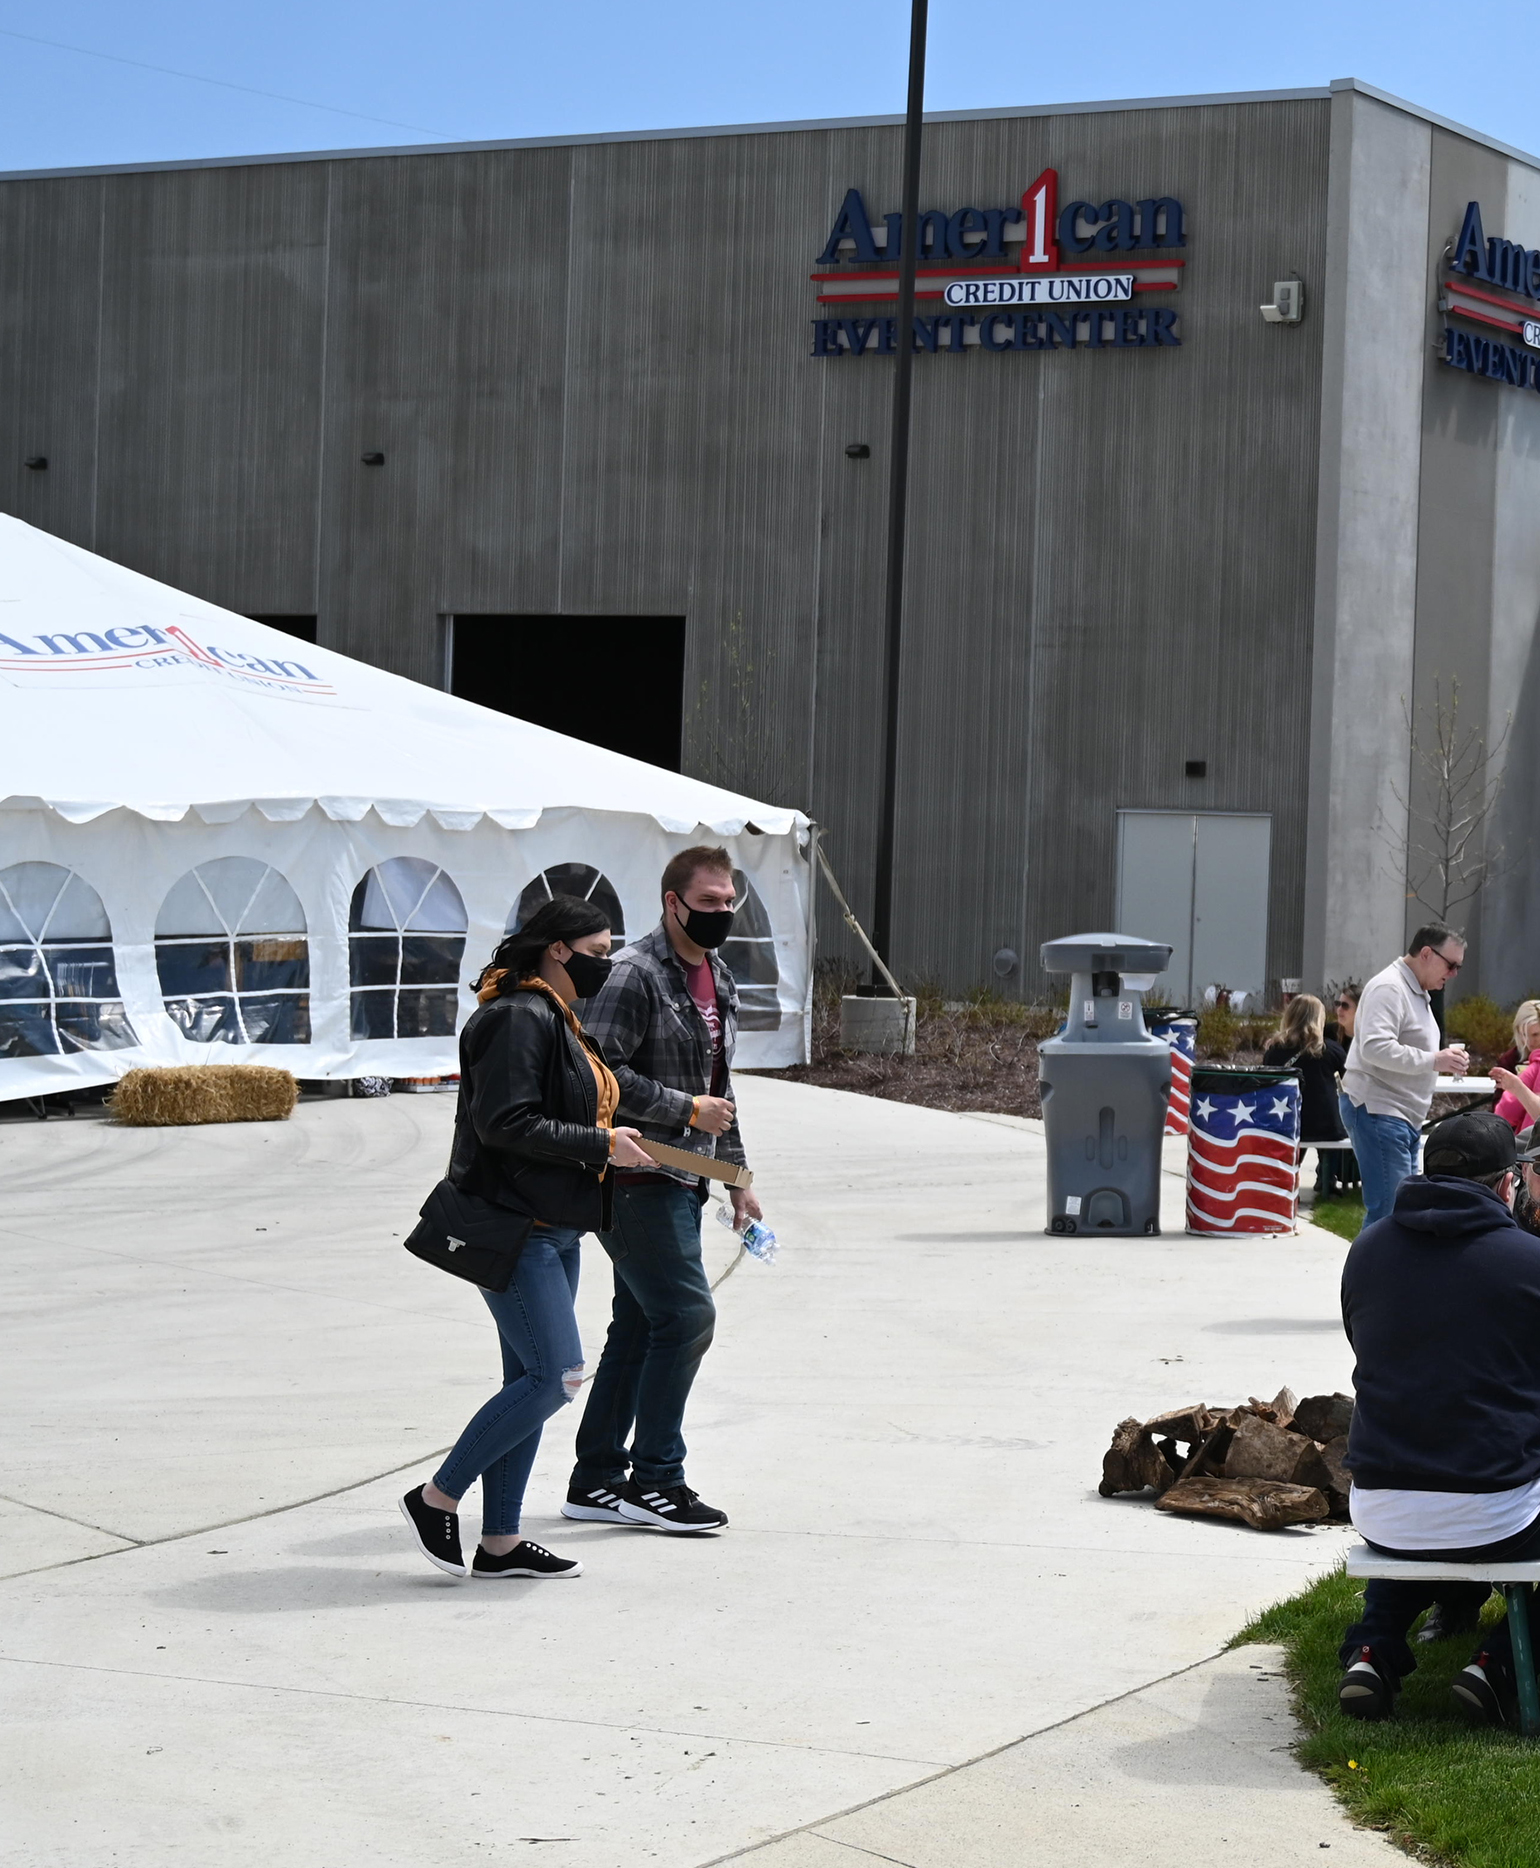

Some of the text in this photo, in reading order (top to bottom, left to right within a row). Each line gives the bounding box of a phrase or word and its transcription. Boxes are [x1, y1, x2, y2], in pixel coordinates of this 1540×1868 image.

[946, 277, 1132, 305] CREDIT UNION
[811, 308, 1182, 357] EVENT CENTER
[1445, 328, 1538, 390] EVENT
